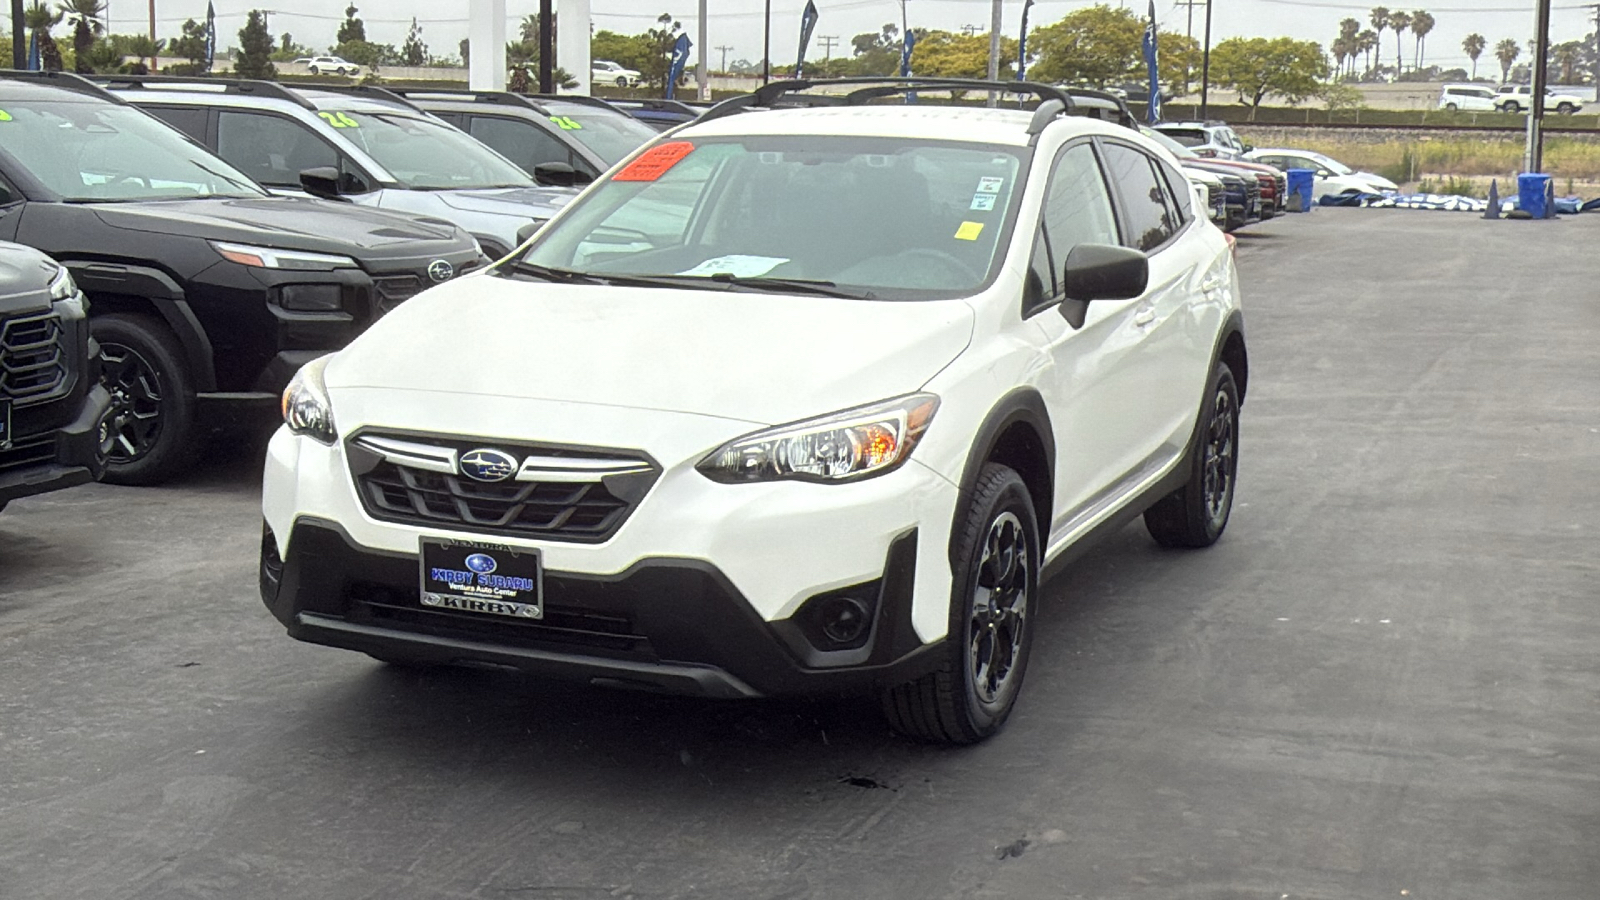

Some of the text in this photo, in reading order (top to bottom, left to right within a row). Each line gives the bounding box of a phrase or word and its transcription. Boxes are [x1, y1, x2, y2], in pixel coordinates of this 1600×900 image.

[318, 111, 360, 128] 26
[549, 116, 583, 130] 26
[431, 567, 534, 591] KIRBY SUBARU
[448, 582, 475, 592] Ventura
[476, 584, 493, 594] Auto
[493, 587, 517, 597] Center
[444, 597, 520, 615] KIRBY
